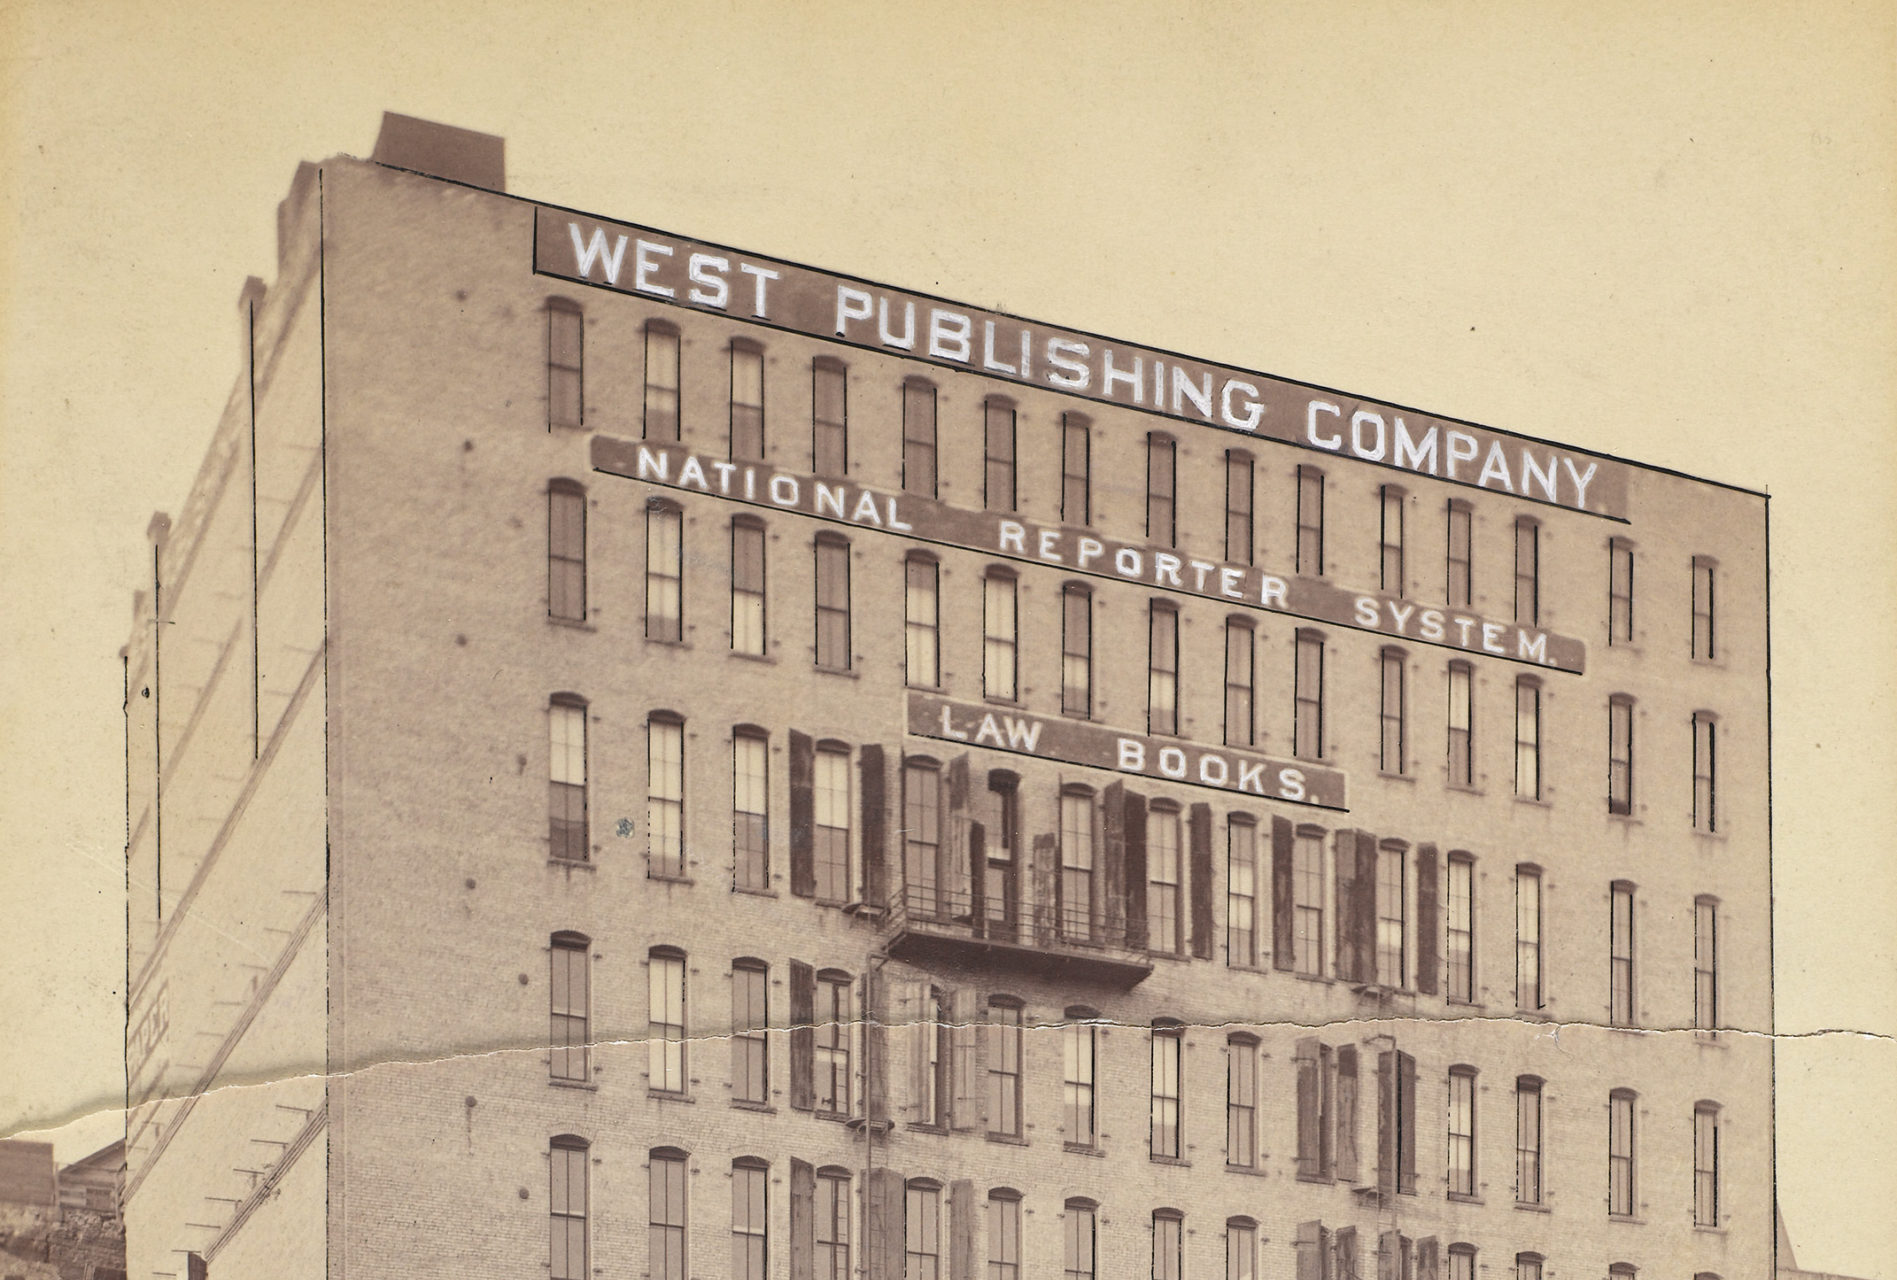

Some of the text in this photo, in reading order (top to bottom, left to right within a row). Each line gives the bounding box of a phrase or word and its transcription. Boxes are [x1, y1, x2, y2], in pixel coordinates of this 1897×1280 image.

[568, 221, 1598, 509] WEST PUBLISHING COMPANY
[637, 447, 1558, 665] NATIONAL REPORTER SYSTEM.
[941, 705, 1319, 804] LAW BOOKS.
